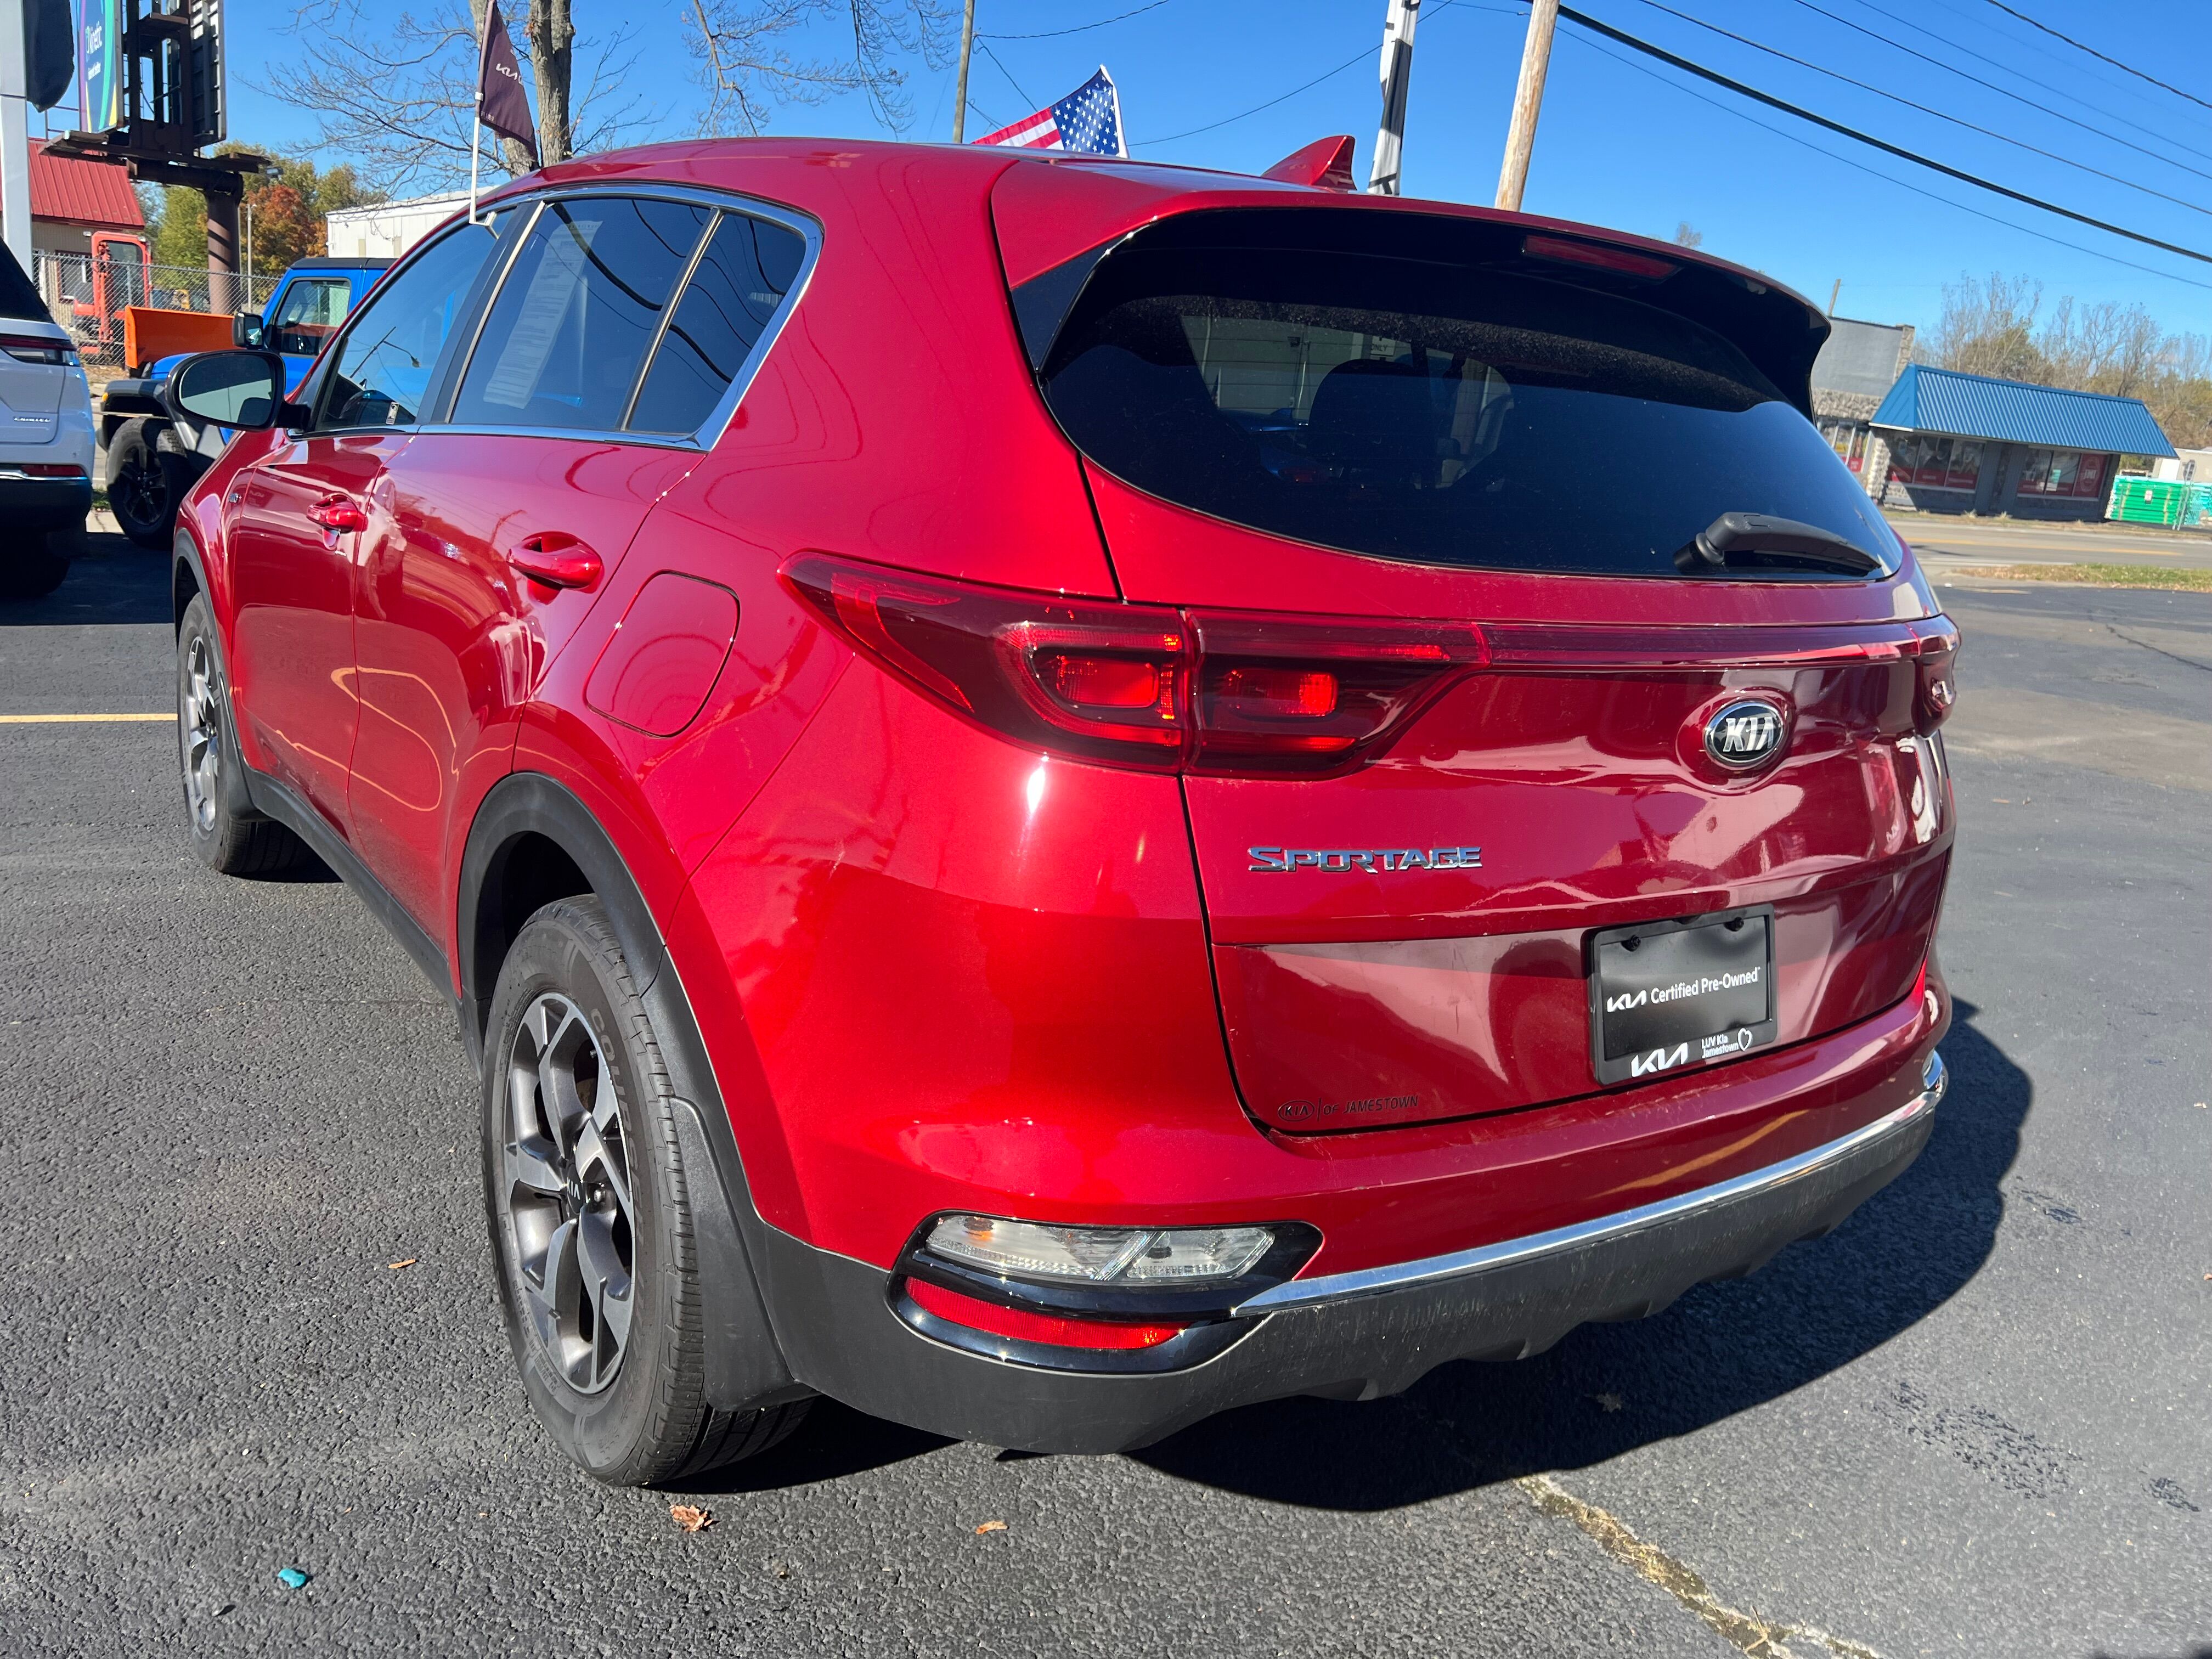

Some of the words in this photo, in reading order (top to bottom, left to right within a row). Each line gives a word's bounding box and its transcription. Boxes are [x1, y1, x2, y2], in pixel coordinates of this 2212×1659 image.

[496, 63, 518, 80] KIA
[1723, 716, 1774, 752] KIA
[1248, 847, 1483, 874] SPORTAGE
[1607, 990, 1646, 1013] KIA
[1651, 979, 1699, 1005] Certified
[1701, 966, 1759, 994] Pre-Owned
[1701, 1037, 1716, 1049] LUV
[1702, 1042, 1739, 1059] Jamestown
[1631, 1042, 1689, 1078] KIA
[1285, 1105, 1309, 1116] KIA
[1323, 1103, 1339, 1115] OF
[1342, 1094, 1419, 1114] JAMESTOWN
[566, 1177, 581, 1200] KIA
